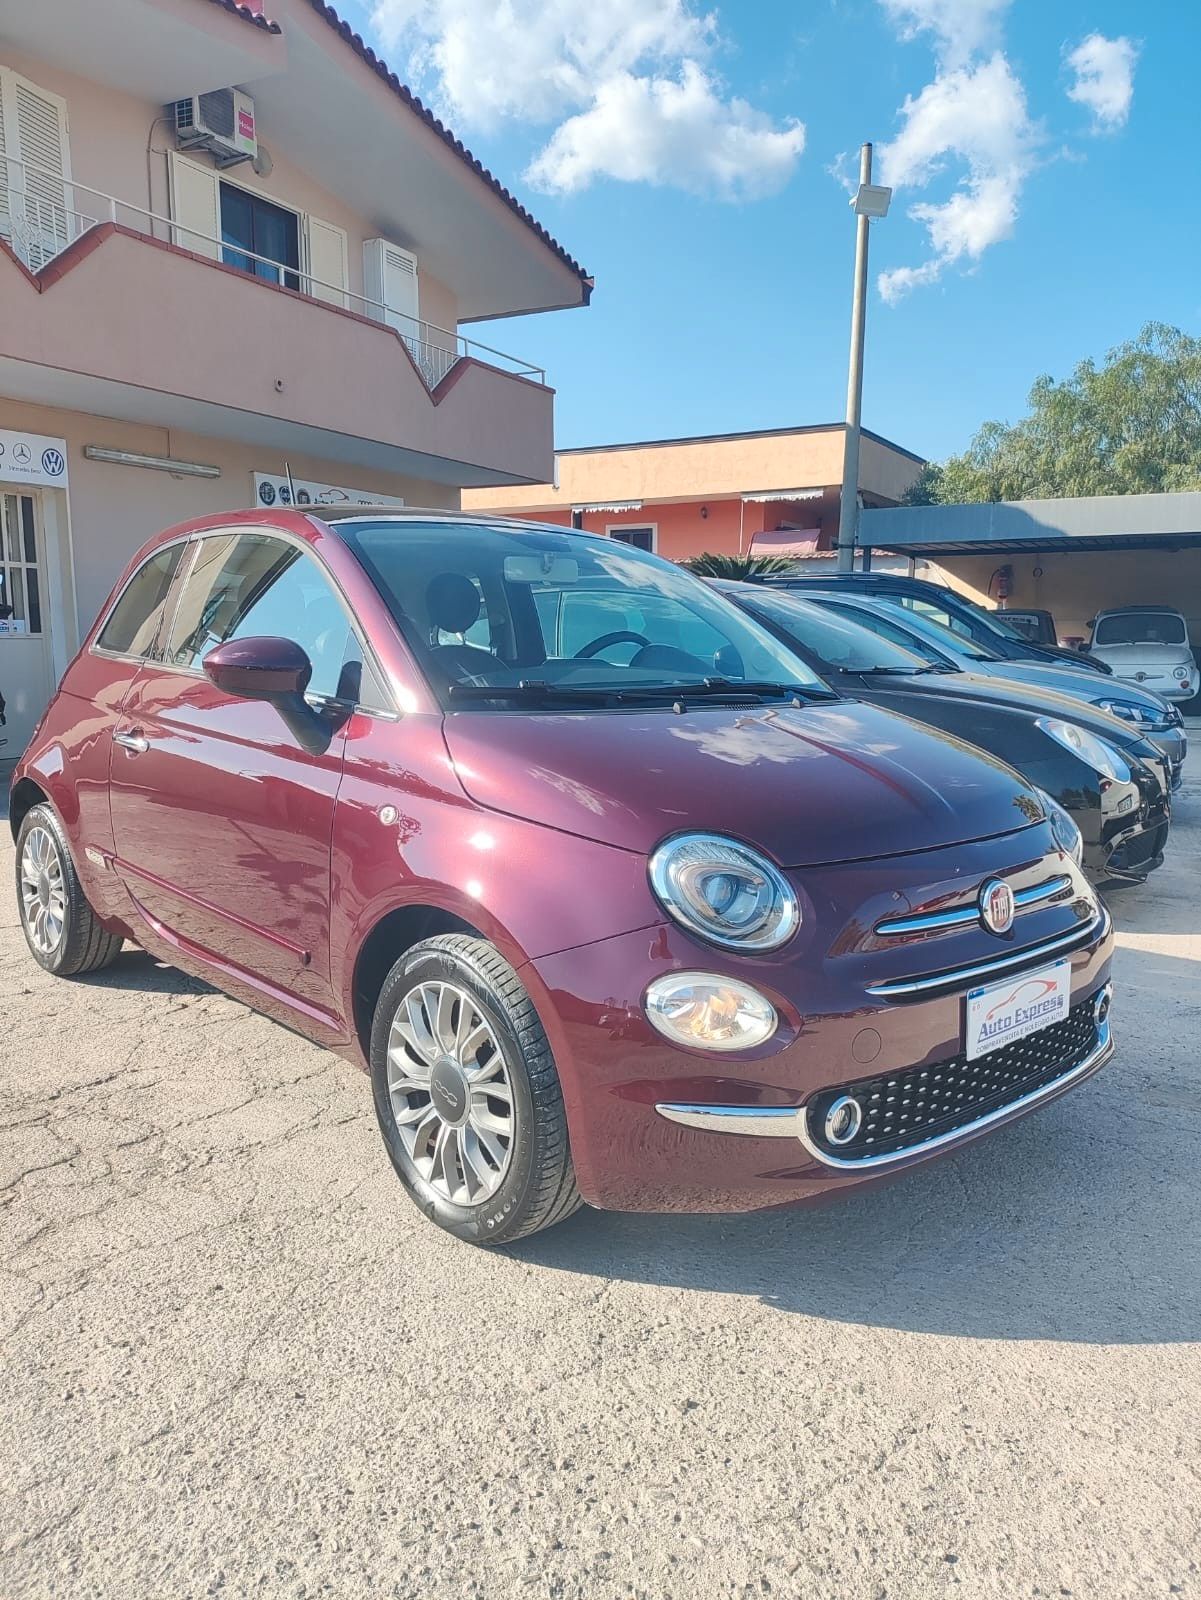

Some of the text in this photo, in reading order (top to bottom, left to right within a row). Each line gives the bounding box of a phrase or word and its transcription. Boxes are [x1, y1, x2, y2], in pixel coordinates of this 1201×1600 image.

[993, 896, 1009, 921] FIAT
[979, 1015, 1012, 1039] Auto
[1015, 994, 1064, 1024] Express
